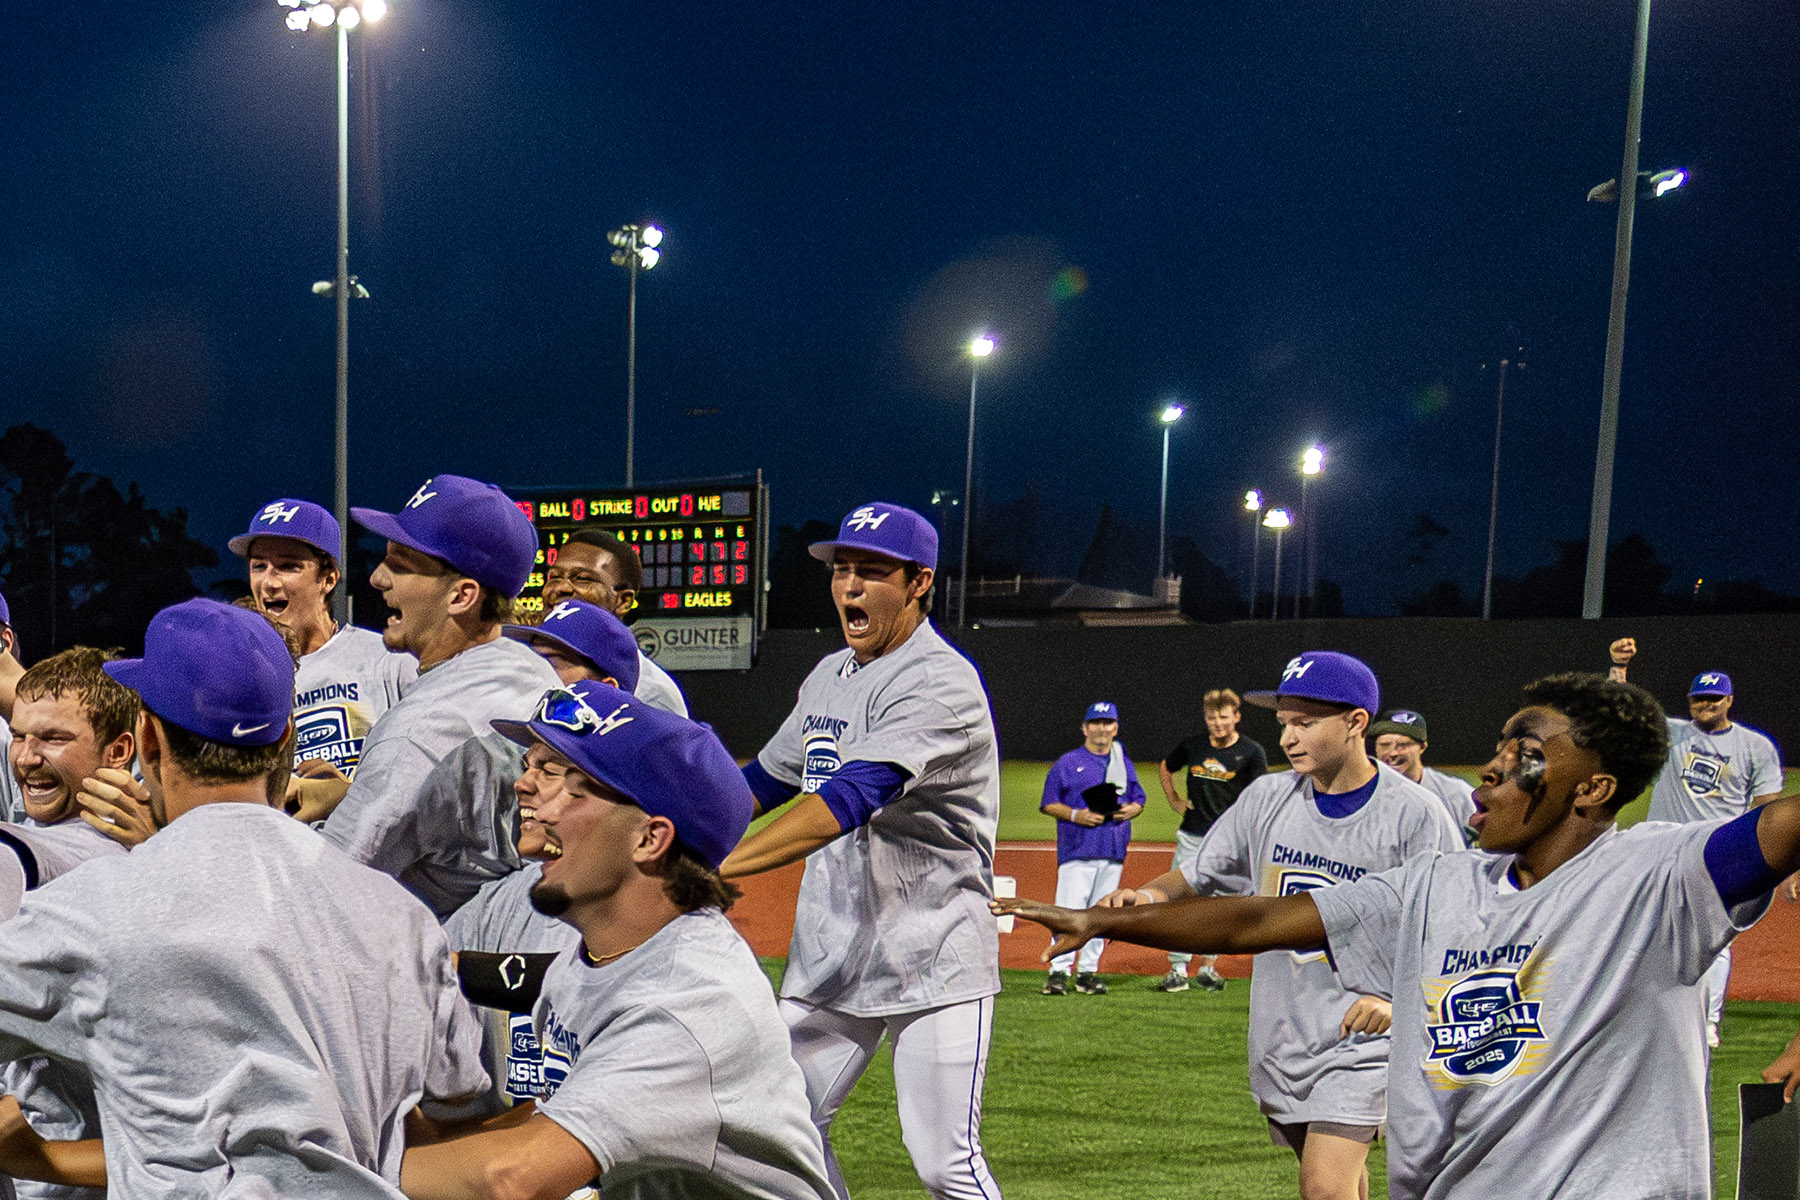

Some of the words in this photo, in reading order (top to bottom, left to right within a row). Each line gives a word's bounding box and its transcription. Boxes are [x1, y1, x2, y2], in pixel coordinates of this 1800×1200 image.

[540, 502, 571, 517] BALL
[572, 499, 586, 521] 0
[590, 499, 633, 516] STRIKE
[635, 496, 649, 518] 0
[651, 497, 680, 513] OUT
[680, 494, 694, 516] 0
[736, 525, 745, 538] E
[692, 542, 704, 561] 4
[714, 541, 725, 560] 7
[735, 540, 746, 560] 2
[692, 565, 704, 585] 2
[713, 564, 725, 584] 5
[735, 564, 746, 584] 3
[684, 591, 733, 608] EAGLES
[663, 627, 739, 646] GUNTER
[296, 682, 359, 707] MPIONS
[293, 740, 360, 770] ASEBALL
[1272, 843, 1367, 884] CHAMPIONS
[1464, 1048, 1506, 1071] 2025
